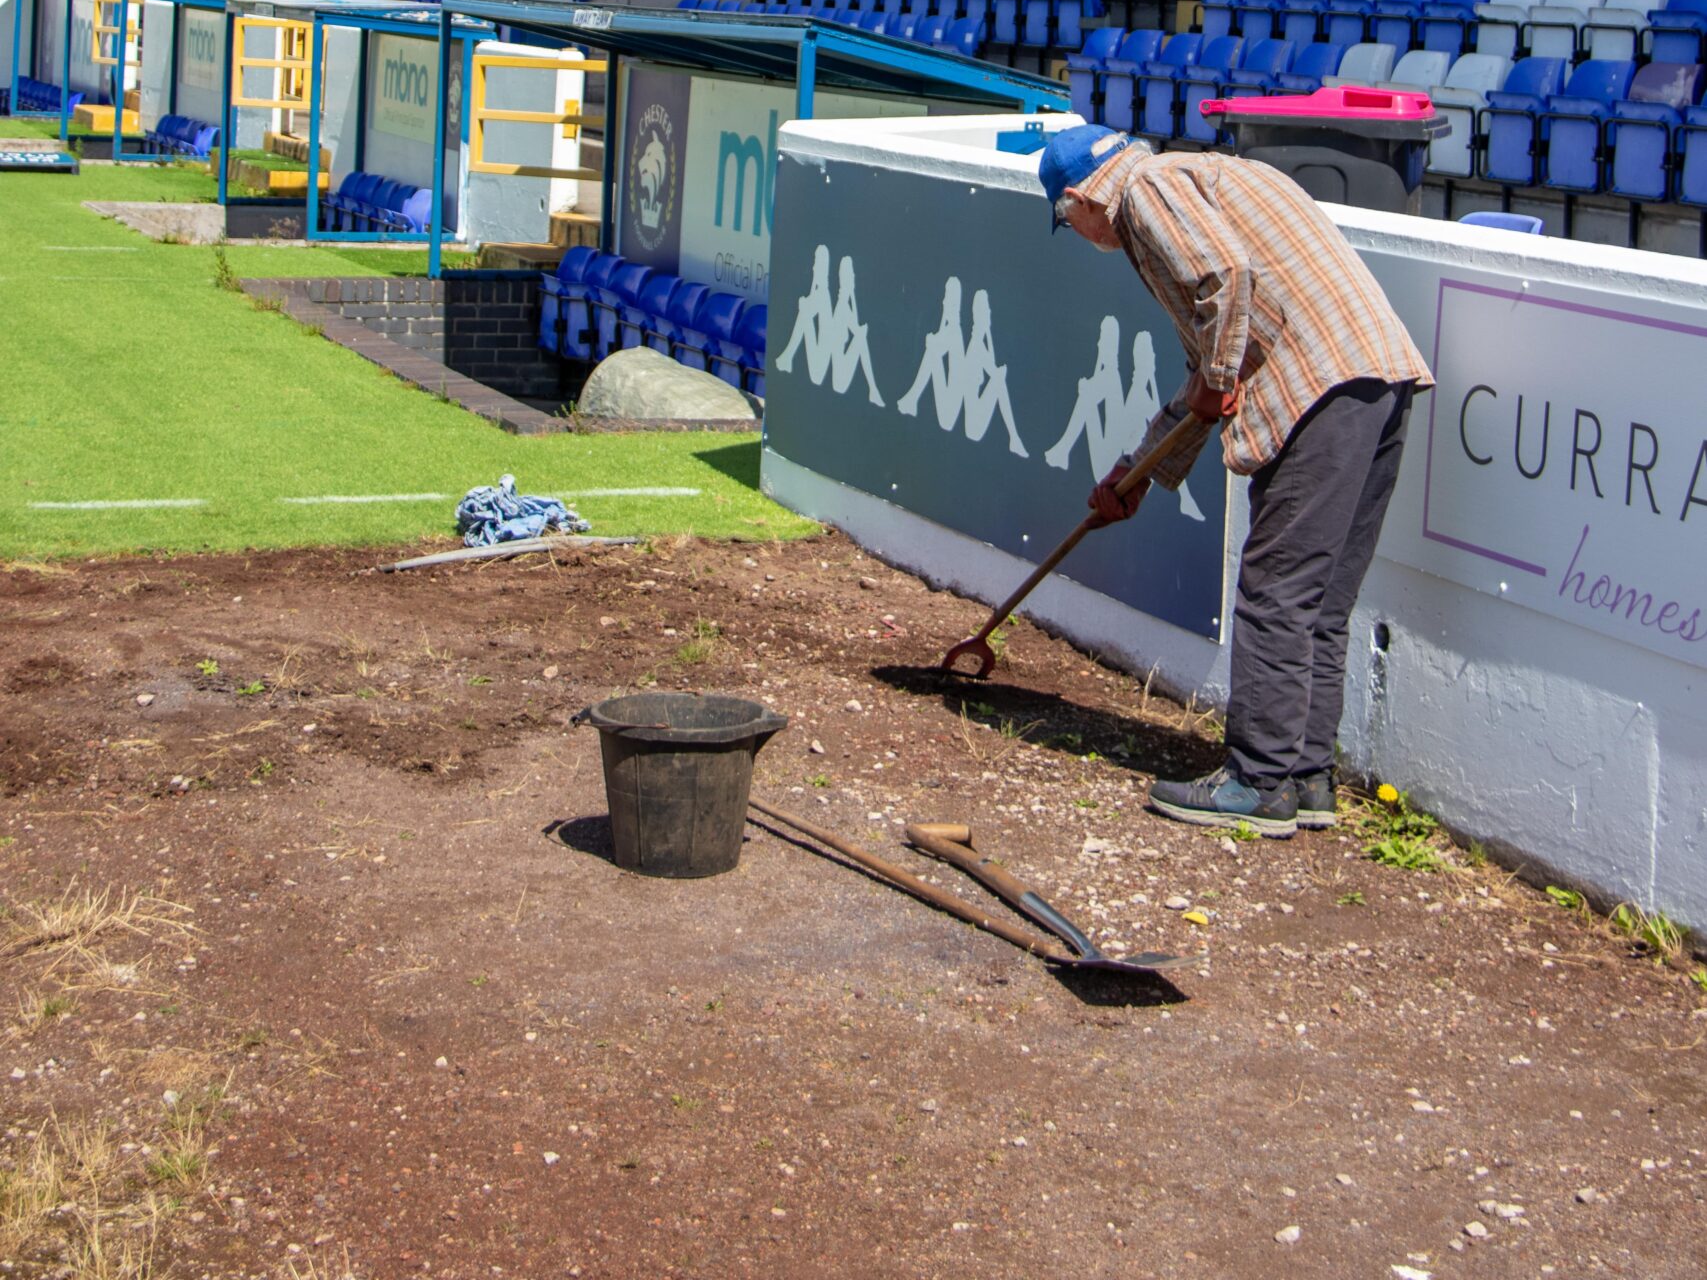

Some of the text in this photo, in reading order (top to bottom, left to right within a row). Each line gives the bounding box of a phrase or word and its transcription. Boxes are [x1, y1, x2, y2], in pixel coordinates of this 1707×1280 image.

[383, 48, 428, 107] mbna
[638, 104, 672, 141] CHESTER
[714, 251, 752, 290] Official
[1559, 523, 1707, 642] homes
